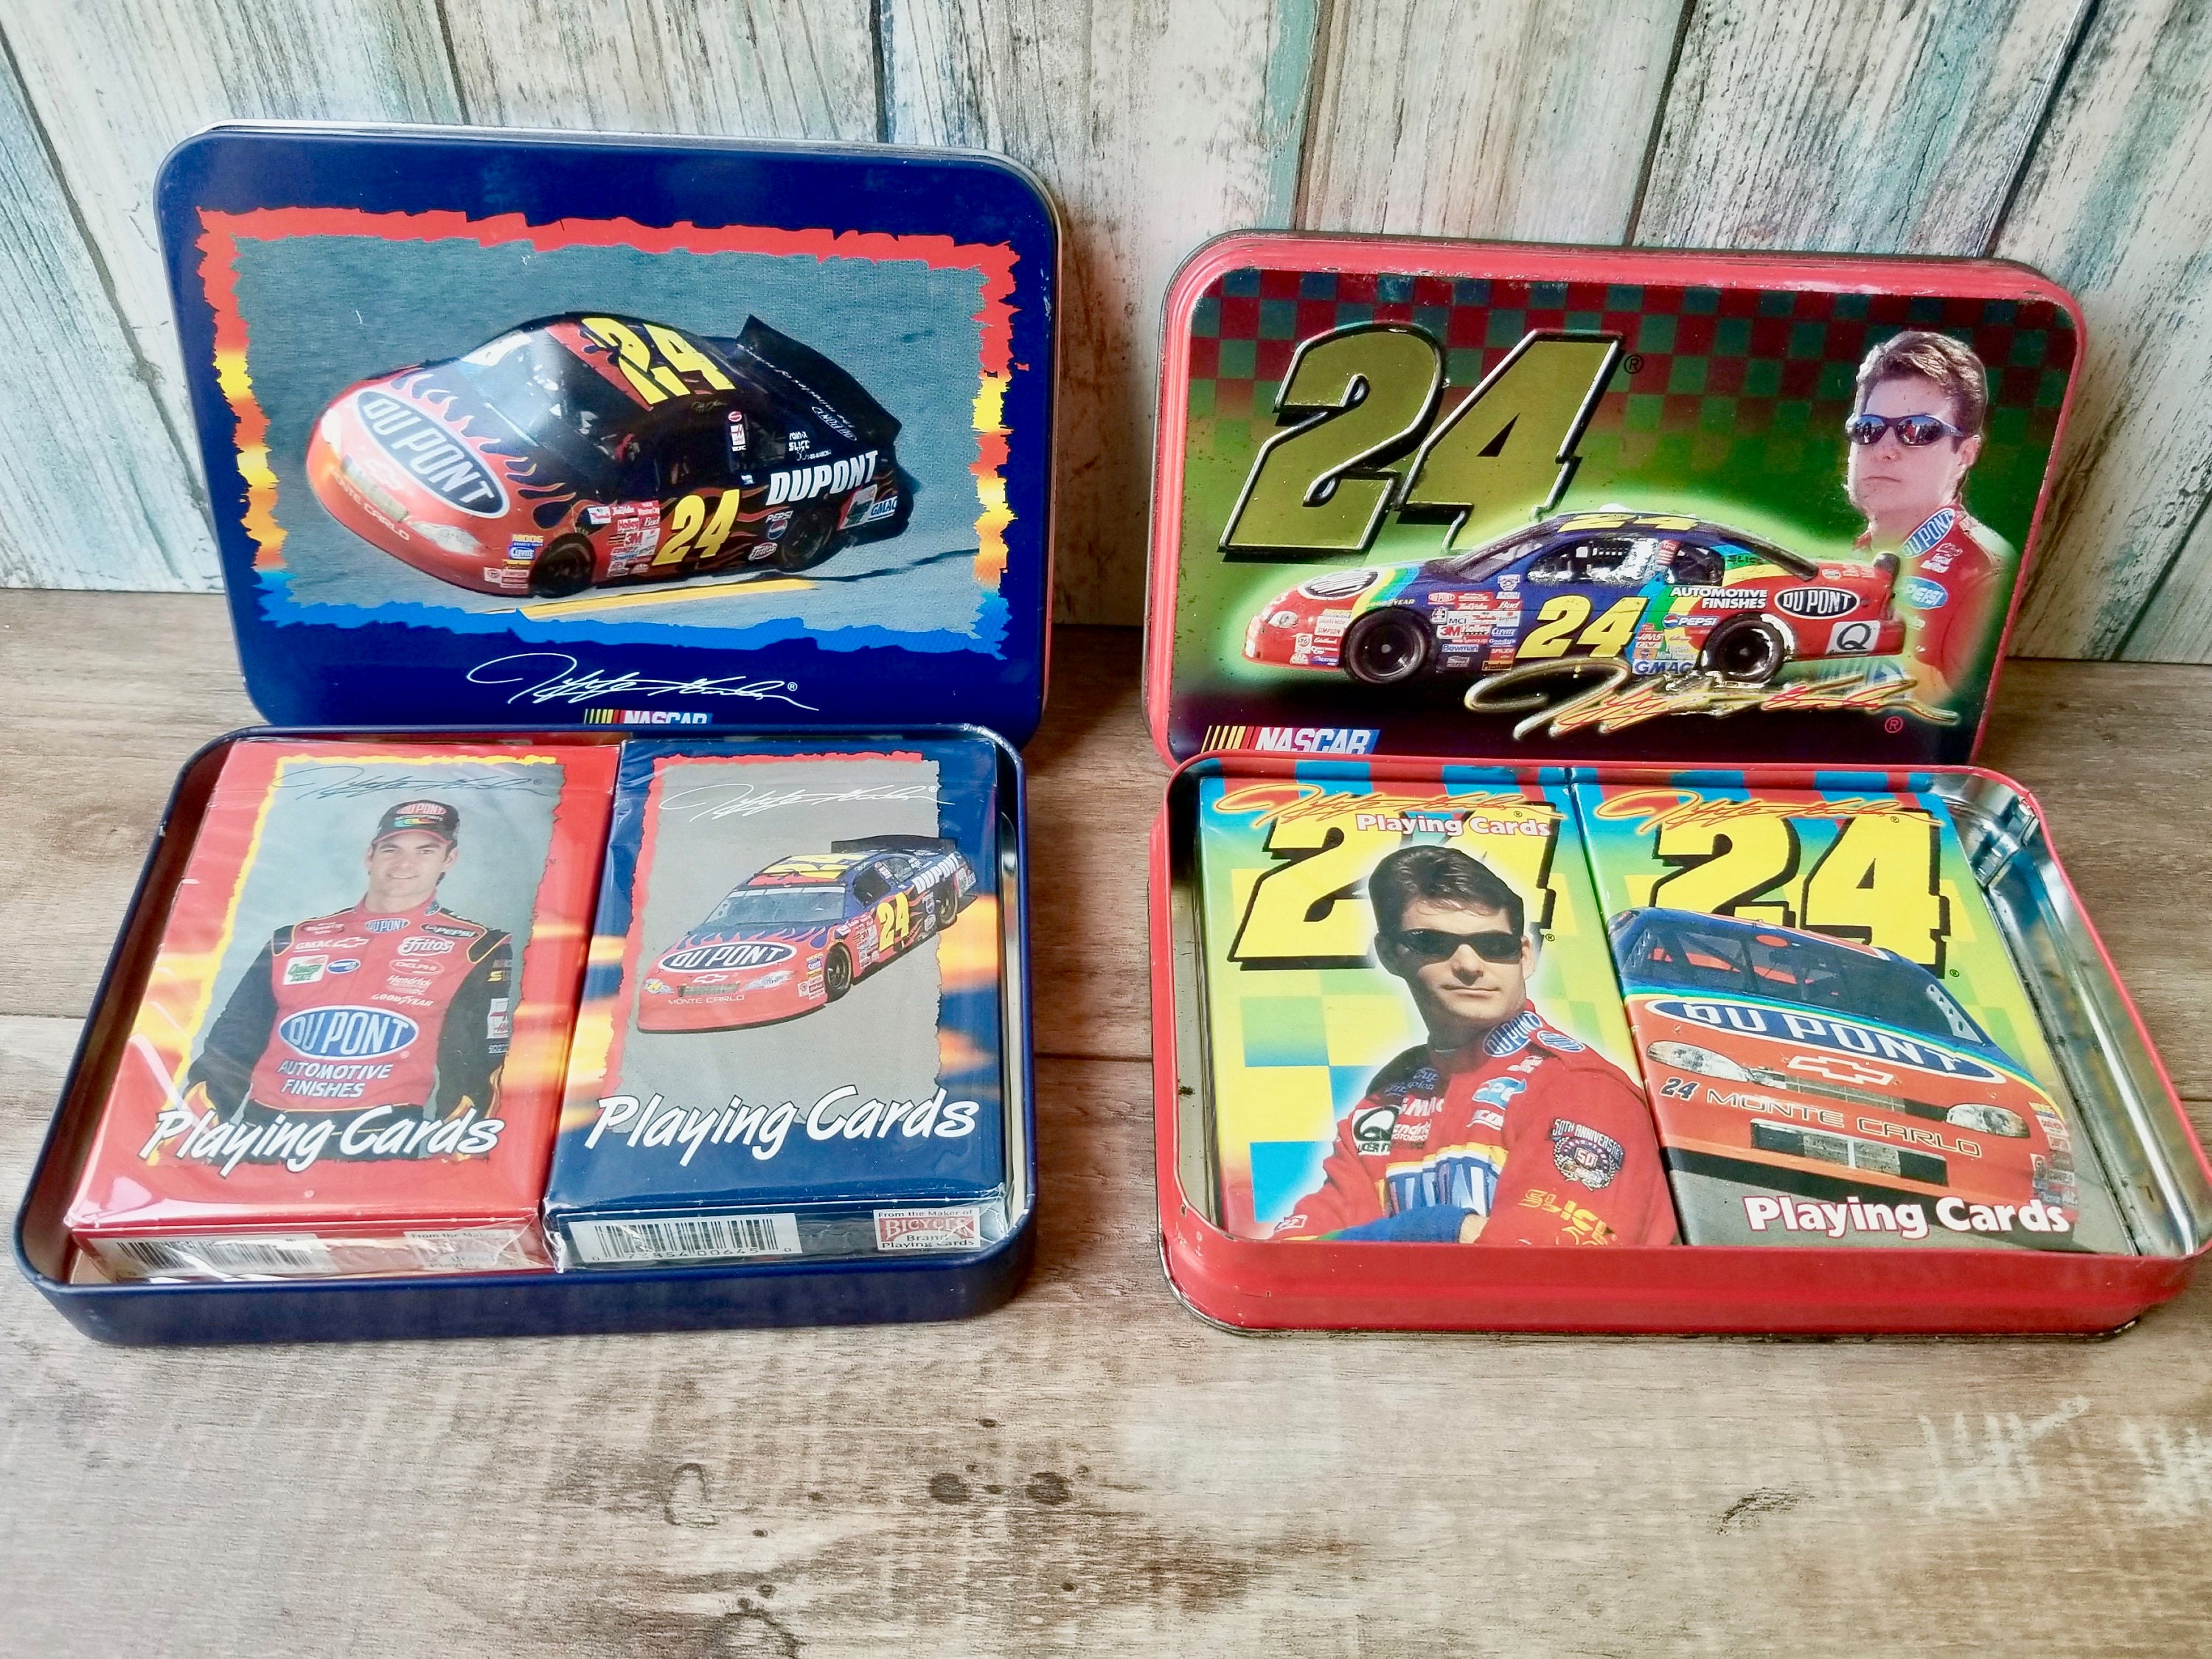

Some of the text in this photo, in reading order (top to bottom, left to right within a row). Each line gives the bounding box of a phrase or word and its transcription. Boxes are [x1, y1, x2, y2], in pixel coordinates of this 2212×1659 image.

[581, 317, 737, 406] 24
[1219, 321, 1623, 554] 24
[400, 425, 495, 506] PONT
[765, 450, 879, 507] DUPONT
[652, 489, 740, 566] 24
[765, 510, 793, 524] PEPSI
[1919, 510, 1952, 548] PONT
[1498, 601, 1520, 609] Bud
[1669, 585, 1768, 598] AUTOMOTIVE
[1701, 597, 1767, 610] FINISHES
[1783, 589, 1851, 615] DU PONT
[1440, 626, 1461, 636] 3M
[1514, 594, 1645, 659] 24
[1678, 616, 1718, 627] PEPSI
[1836, 622, 1867, 651] Q
[1633, 661, 1694, 675] GMAC
[1254, 726, 1371, 755] NASCAR
[1357, 813, 1551, 837] Playing Cards
[911, 852, 959, 895] DUPONT
[1651, 804, 1951, 981] 24
[877, 891, 910, 953] 24
[400, 936, 454, 954] Fritos
[667, 945, 793, 969] DU PONT
[371, 993, 434, 1007] GOODYEAR
[667, 995, 745, 1006] MONTE CARLO
[288, 1011, 410, 1055] DU PONT
[1683, 1003, 1963, 1073] DU PONT
[278, 1060, 394, 1080] AUTOMOTIVE
[281, 1079, 366, 1098] FINISHES
[1660, 1077, 1701, 1102] 24
[584, 1083, 980, 1167] Playing Cards
[1552, 1119, 1575, 1136] 50TH
[1706, 1088, 1982, 1158] MONTE CARLO
[138, 1105, 505, 1178] Playing Cards
[1744, 1195, 2070, 1239] Playing Cards
